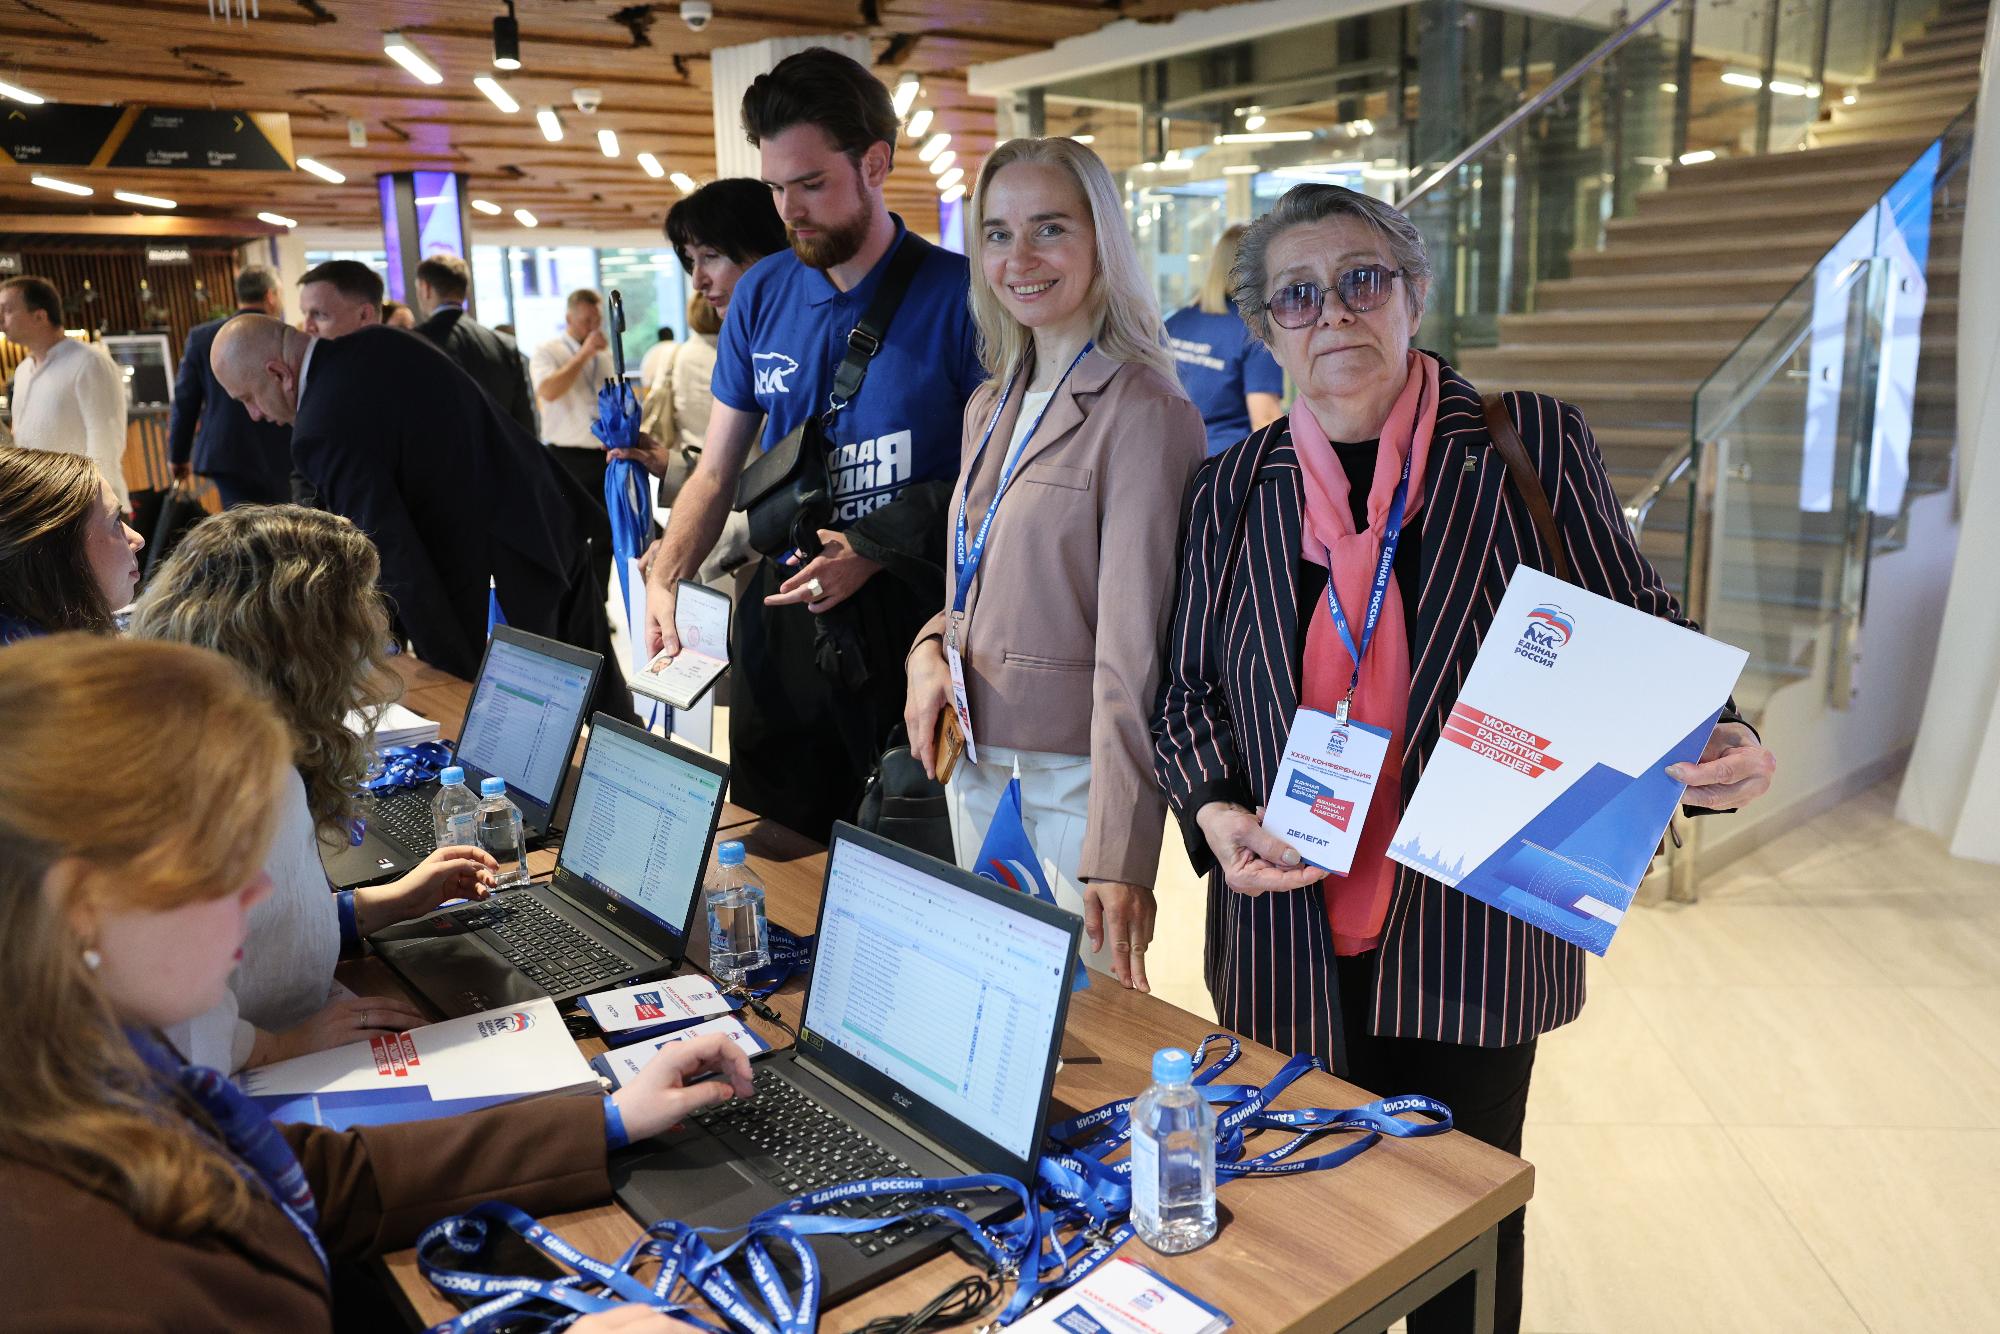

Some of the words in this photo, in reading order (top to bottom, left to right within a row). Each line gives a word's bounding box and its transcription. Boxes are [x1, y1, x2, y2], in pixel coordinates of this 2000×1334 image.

[975, 513, 992, 550] ЕДИНАЯ
[1376, 546, 1392, 586] ЕДИНАЯ
[1367, 590, 1382, 628] РОССИЯ
[1514, 646, 1555, 668] РОССИЯ
[1517, 639, 1558, 660] ЕДИНАЯ
[1482, 715, 1537, 746] МОСКВА
[1477, 727, 1544, 764] РАЗВИТИЕ
[1470, 740, 1533, 775] БУДУЩЕЕ
[1312, 758, 1372, 780] КОНФЕРЕНЦИЯ
[1292, 783, 1319, 795] РОССИЯ
[1294, 778, 1320, 791] ЕДИНАЯ
[1313, 808, 1345, 822] НАВСЕГДА
[1315, 803, 1340, 815] СТРАНА
[1316, 798, 1346, 811] ВЕЛИКАЯ
[1287, 828, 1330, 847] ДЕЛЕГАТ
[1223, 1099, 1262, 1128] ЕДИНАЯ
[1382, 1098, 1427, 1113] РОССИЯ
[1076, 1107, 1112, 1129] РОССИЯ
[1256, 1162, 1305, 1172] РОССИЯ
[812, 1183, 866, 1204] ЕДИНАЯ
[872, 1179, 923, 1191] РОССИЯ
[542, 1235, 583, 1263] ЕДИНАЯ
[577, 1259, 616, 1280] РОССИЯ
[430, 1271, 481, 1292] РОССИЯ
[484, 1277, 543, 1293] ЕДИНАЯ
[702, 1279, 734, 1309] РОССИЯ
[763, 1281, 793, 1322] ЕДИНАЯ
[796, 1281, 813, 1325] ЕДИНАЯ
[459, 1290, 524, 1328] ЕДИНАЯ
